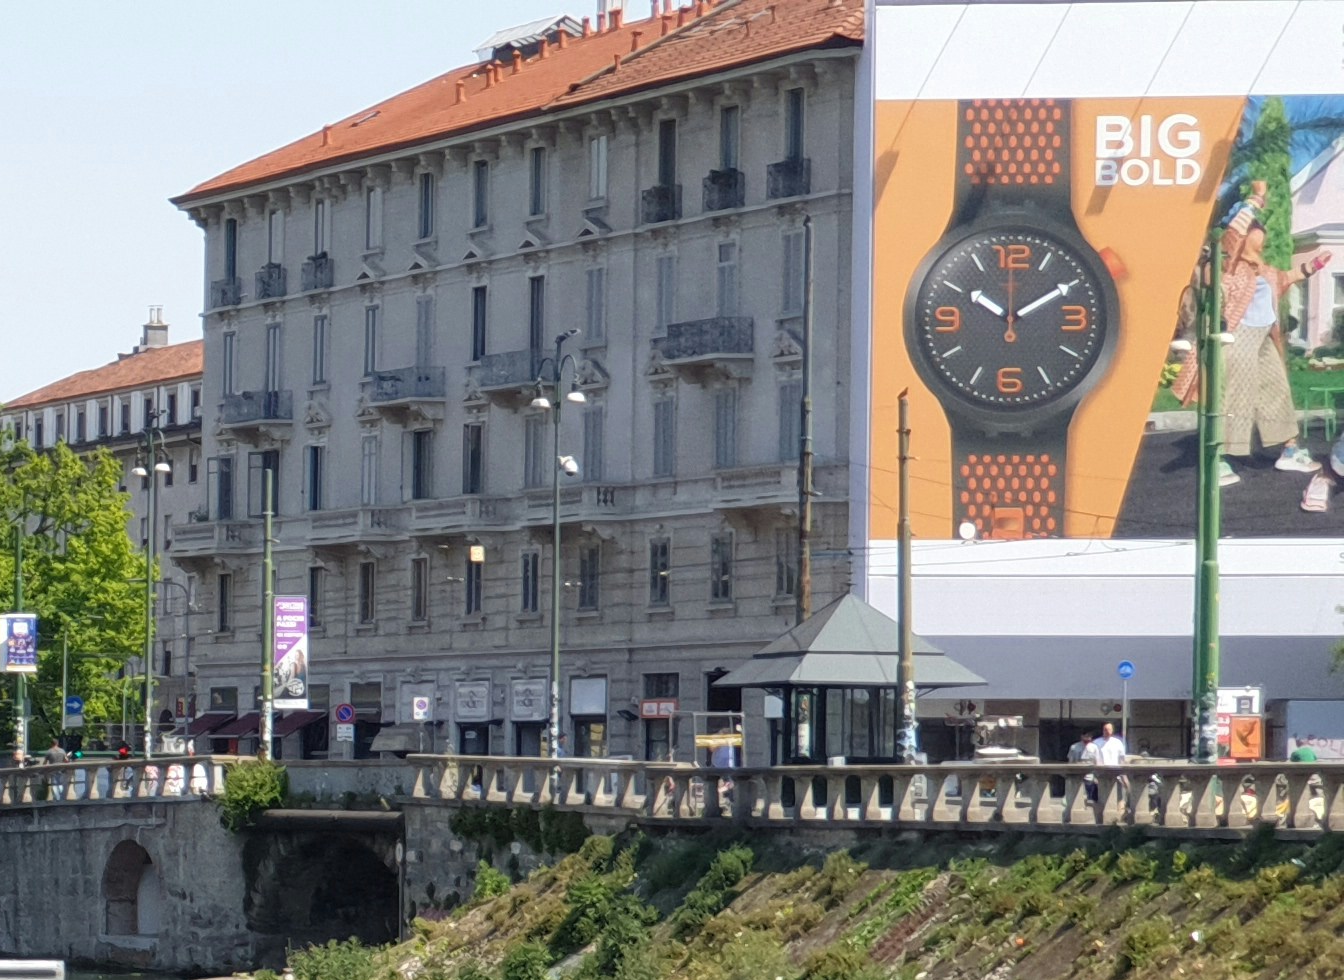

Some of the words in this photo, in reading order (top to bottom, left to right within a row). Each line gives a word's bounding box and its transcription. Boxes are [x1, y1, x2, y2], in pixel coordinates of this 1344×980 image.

[1096, 113, 1201, 158] BIG
[1095, 158, 1201, 186] BOLD
[992, 245, 1032, 269] 12
[935, 306, 961, 333] 9
[1060, 305, 1089, 331] 3
[997, 367, 1023, 394] 6
